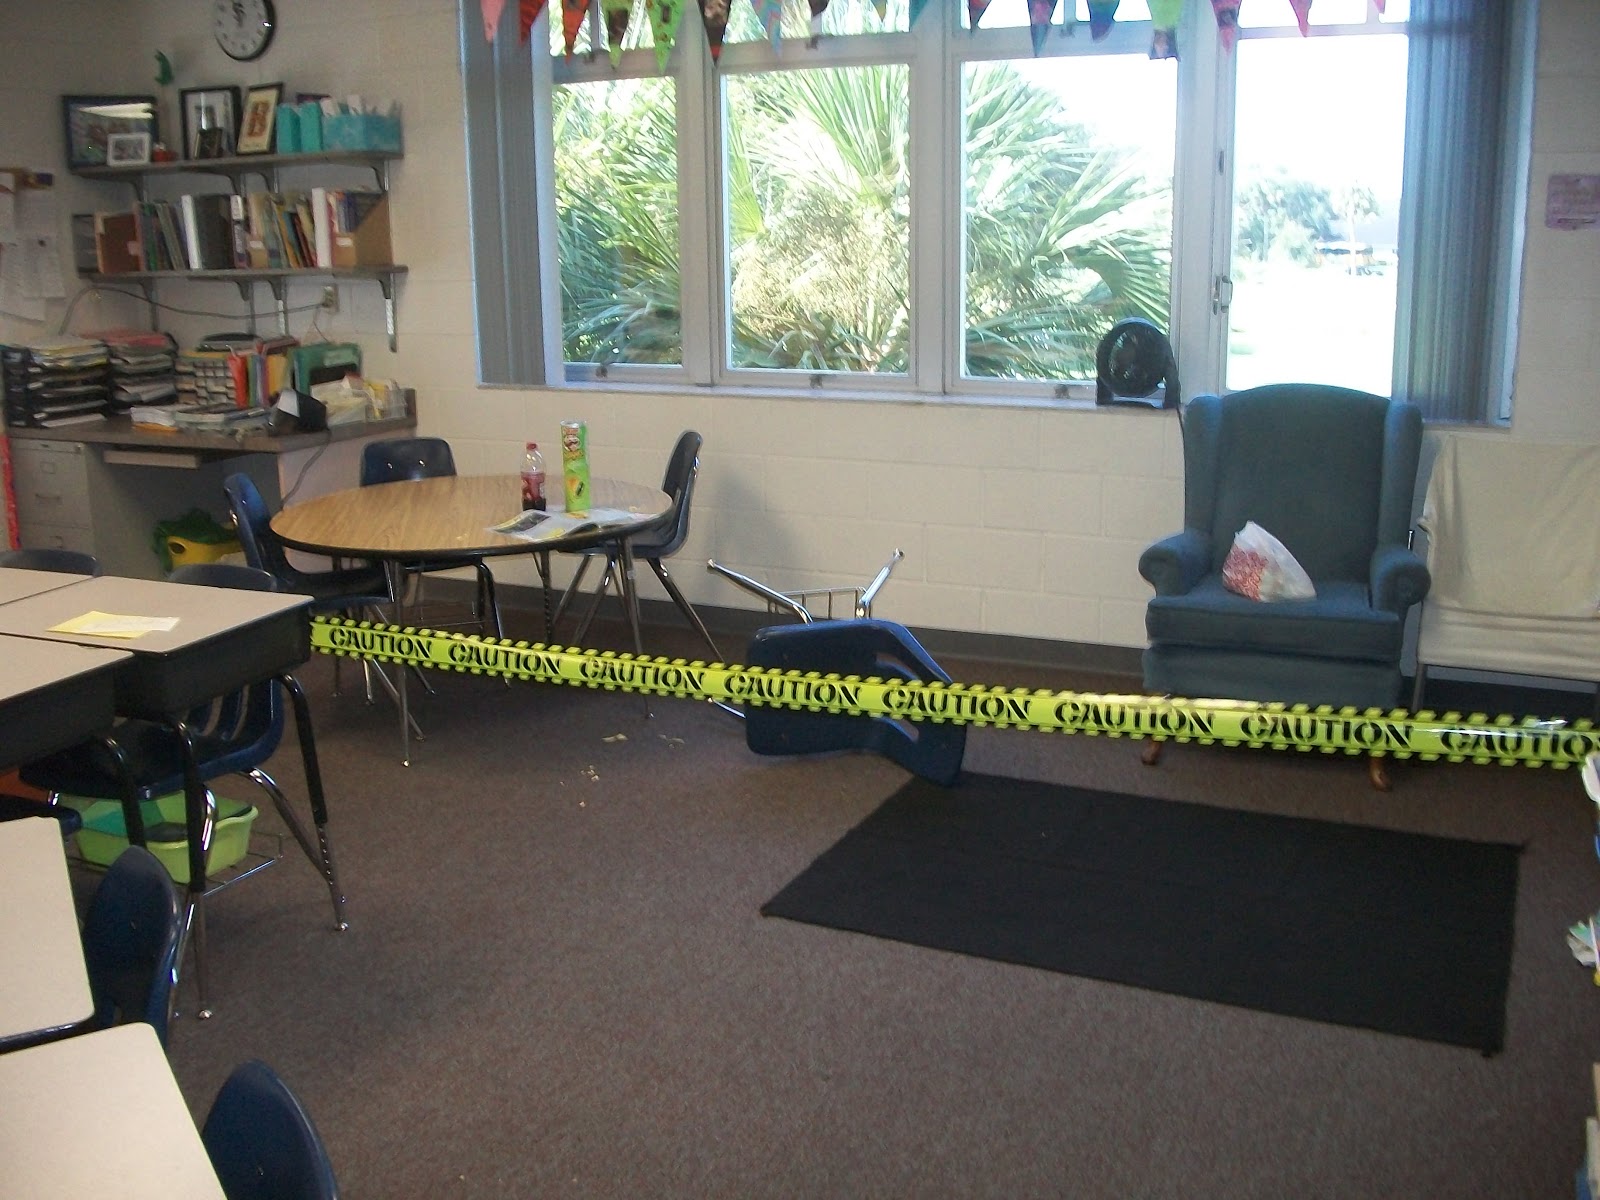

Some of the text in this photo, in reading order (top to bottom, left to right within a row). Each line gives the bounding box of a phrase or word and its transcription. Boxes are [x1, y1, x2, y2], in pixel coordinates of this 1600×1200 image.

[329, 626, 1600, 759] CAUTION CAUTION CAUTION CAUTION CAUTION CAUTION CAUTION CAUTIO
